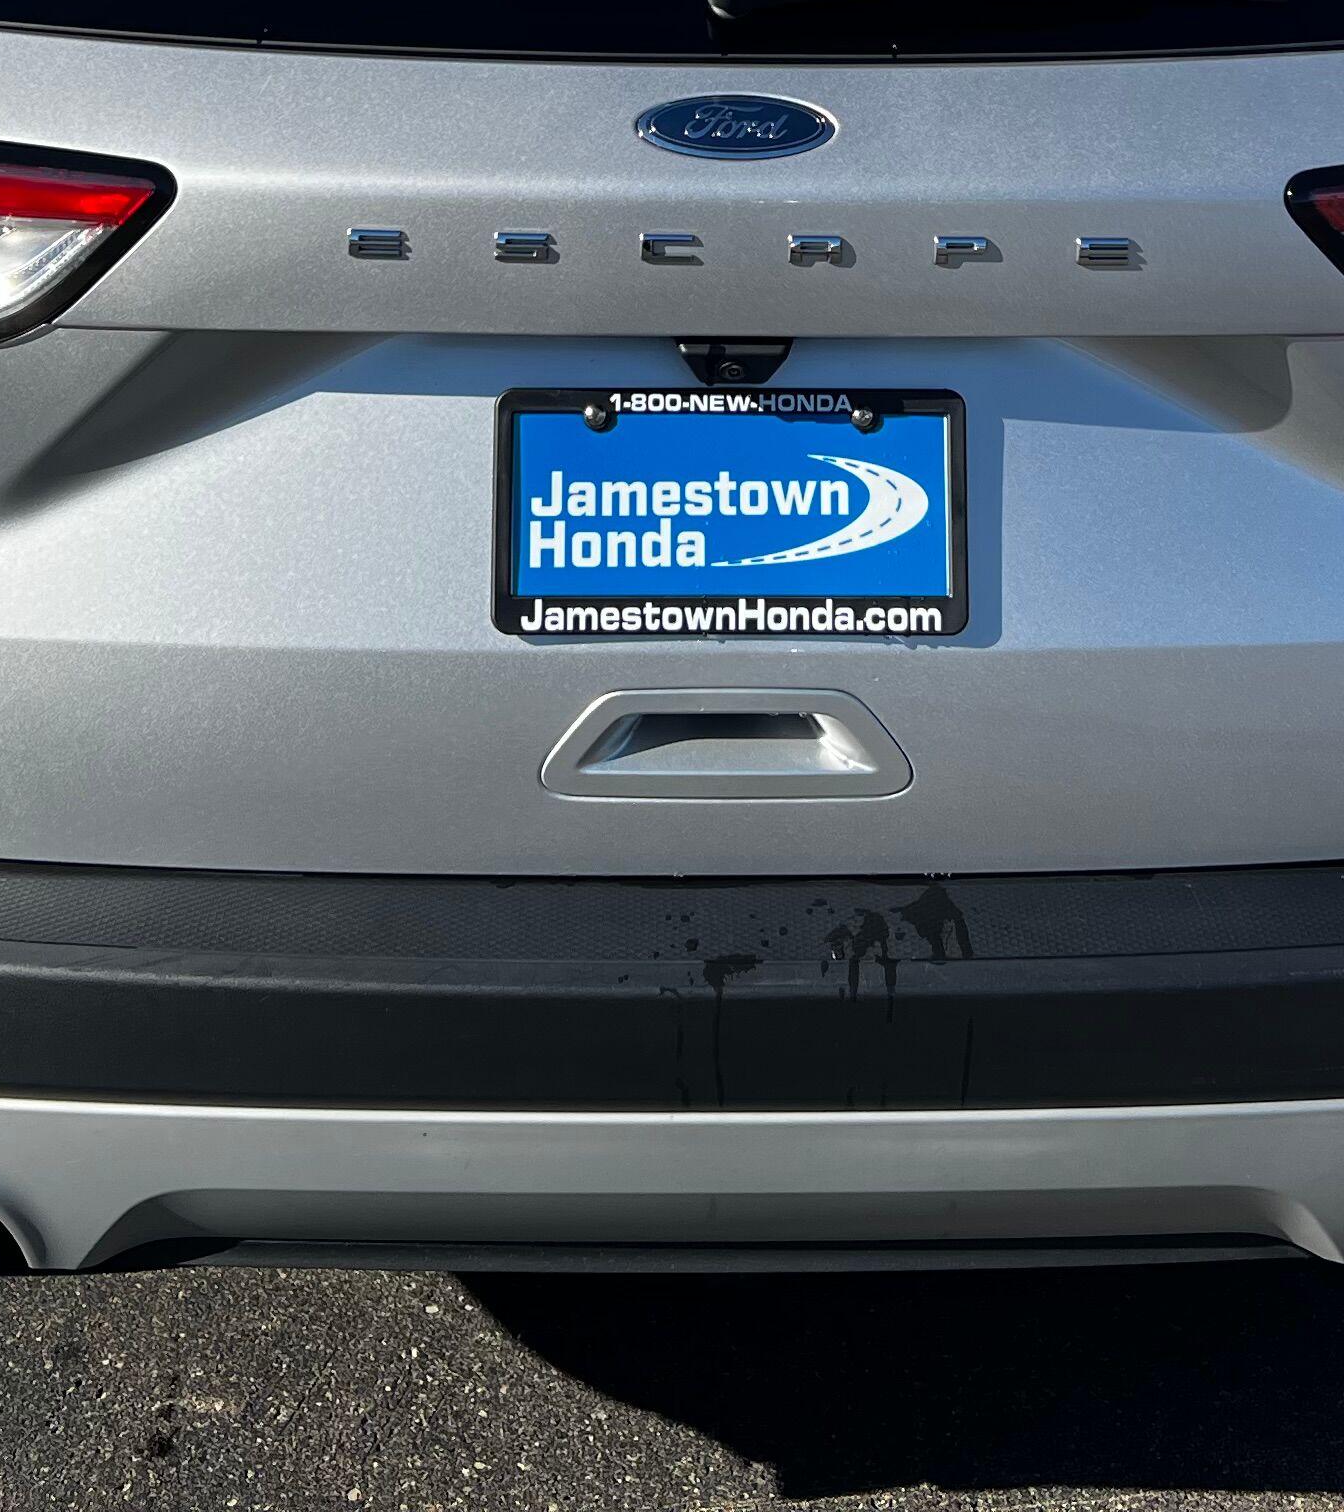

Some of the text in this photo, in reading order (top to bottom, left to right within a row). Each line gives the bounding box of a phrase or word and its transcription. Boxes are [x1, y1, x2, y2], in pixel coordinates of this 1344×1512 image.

[684, 104, 788, 139] Ford
[347, 228, 1131, 266] ESCAPE
[609, 393, 852, 412] 1-800-NEW-HONDA
[531, 471, 849, 516] Jamestown
[529, 519, 705, 568] Honda
[521, 599, 942, 632] JamestownHonda.com
